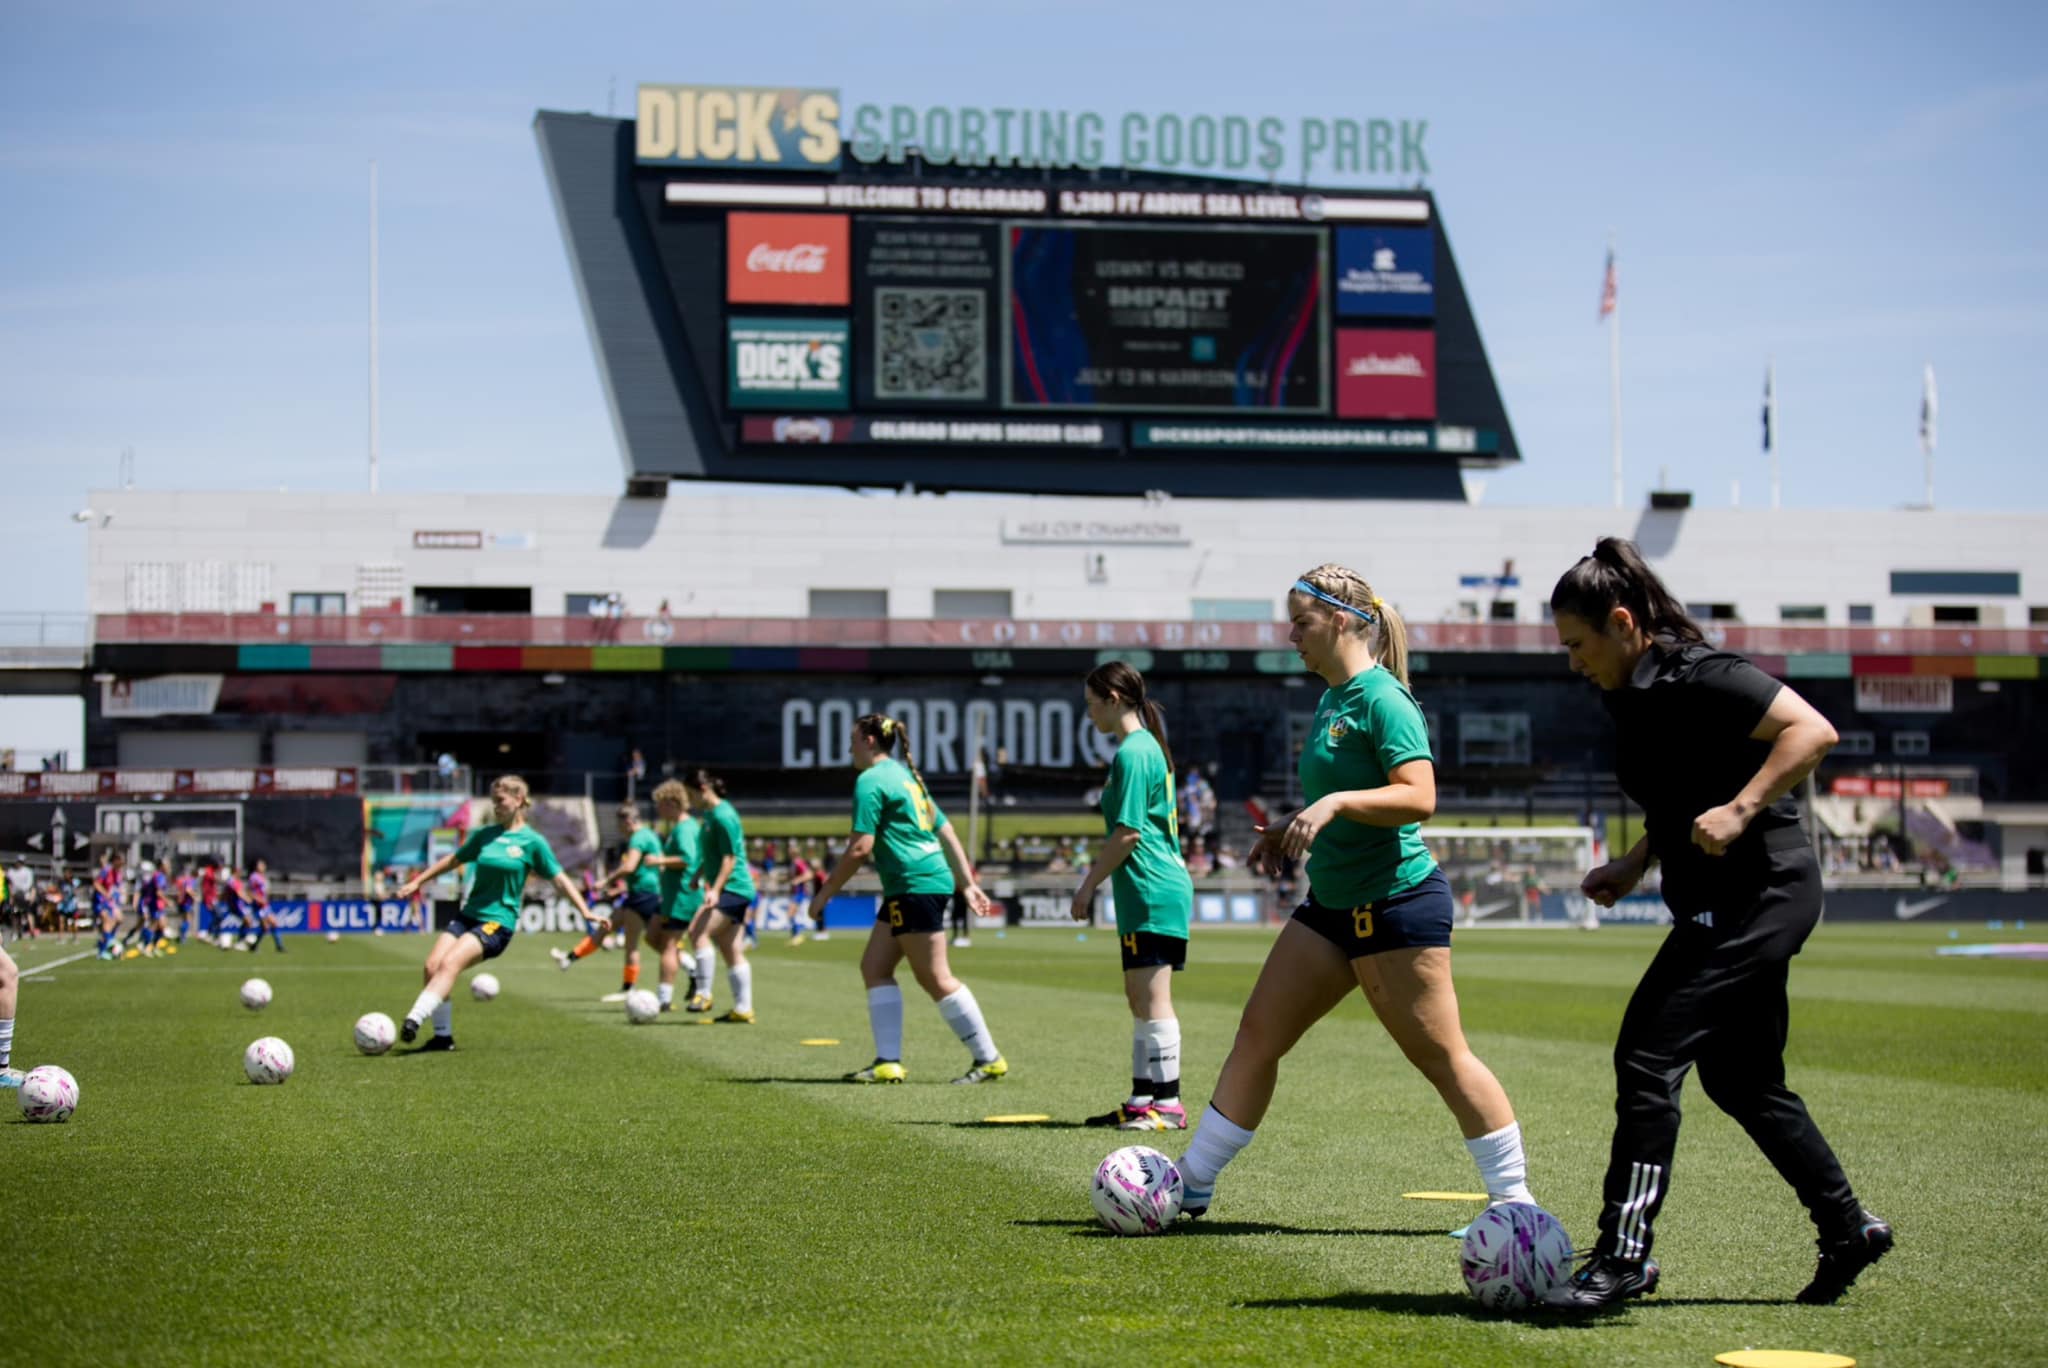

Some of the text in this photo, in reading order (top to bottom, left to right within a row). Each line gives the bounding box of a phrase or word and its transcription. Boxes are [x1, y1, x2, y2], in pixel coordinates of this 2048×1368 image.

[638, 88, 1431, 174] DICK'S SPORTING GOODS PARK
[1108, 286, 1231, 309] IMPACT
[737, 343, 841, 380] DICK'S
[782, 700, 1076, 773] COORADO
[1124, 932, 1138, 956] 4
